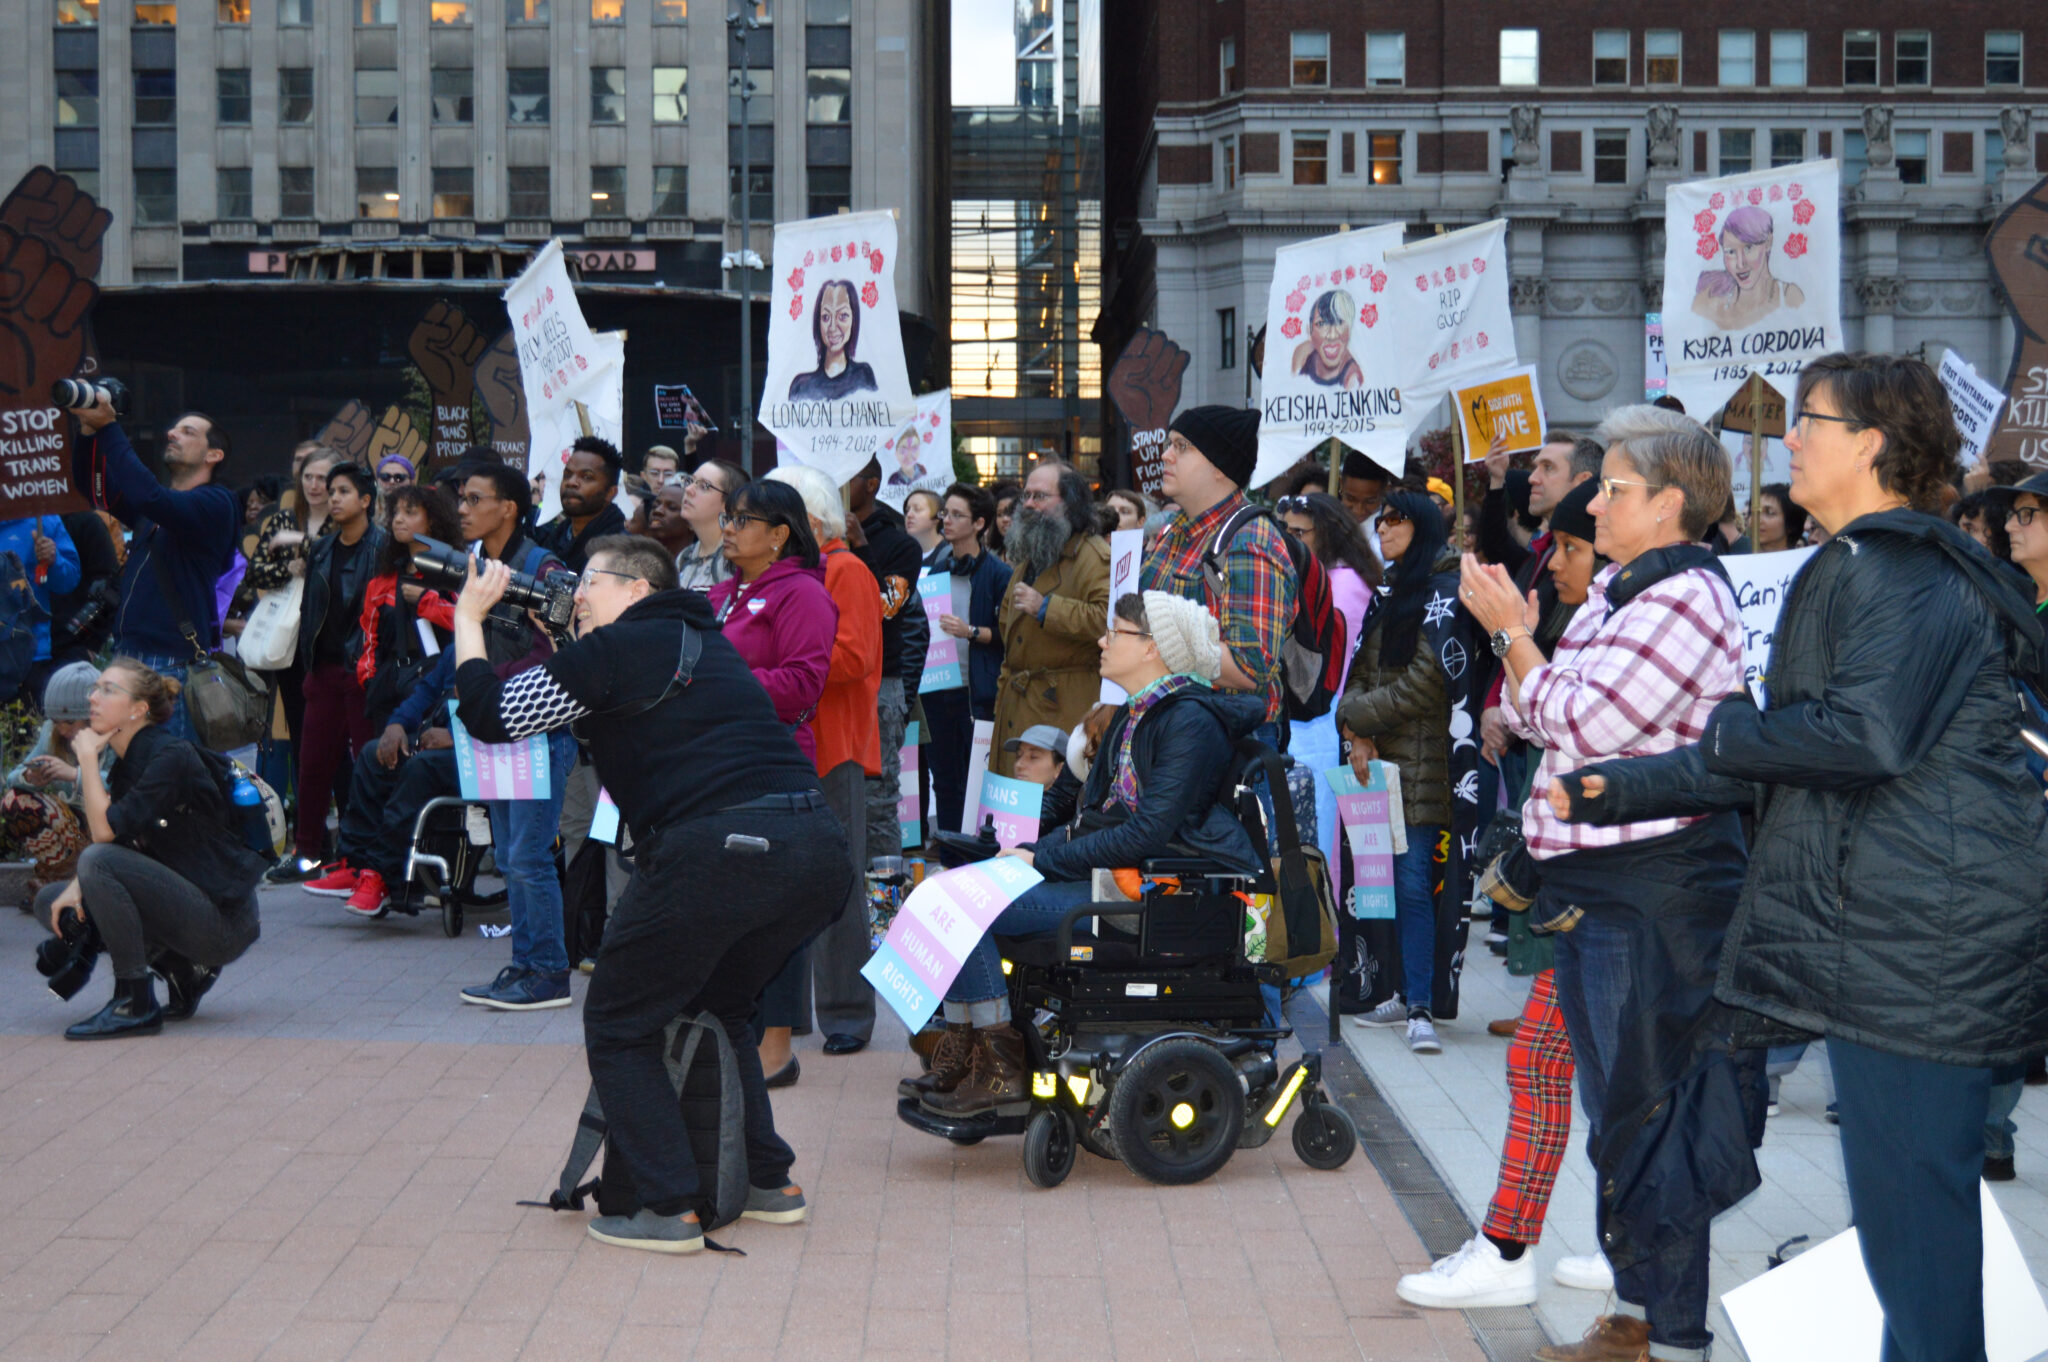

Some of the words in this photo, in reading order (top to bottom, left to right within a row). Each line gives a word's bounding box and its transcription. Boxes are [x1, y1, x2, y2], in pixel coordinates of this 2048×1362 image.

[585, 253, 636, 271] OAD
[1440, 288, 1460, 309] RIP
[1437, 309, 1469, 330] GUCC
[1684, 335, 1733, 360] KYRA
[1741, 326, 1826, 354] CORDOVA
[1265, 393, 1328, 424] KEISHA
[1331, 387, 1402, 418] JENKINS
[1957, 376, 1994, 413] UNITARIAN
[3, 408, 61, 434] STOP
[437, 405, 470, 421] BLACK
[772, 402, 832, 428] LONDON
[841, 402, 896, 427] CHANEL
[1953, 402, 1978, 433] PORTS
[2007, 396, 2048, 429] KILL
[438, 423, 467, 439] TRANS
[1304, 417, 1376, 437] 1993-2015
[1493, 411, 1530, 439] LOVE
[0, 434, 63, 457] KILLING
[812, 435, 877, 452] 1994-2018
[1132, 428, 1166, 450] STAND
[1140, 445, 1160, 462] UP!
[5, 456, 61, 477] TRANS
[1136, 462, 1164, 480] FIGH
[2, 477, 69, 500] WOMEN
[917, 581, 938, 594] ANS
[1737, 574, 1789, 609] Can't
[927, 648, 946, 660] MAN
[921, 669, 951, 685] IGHTS
[477, 740, 491, 780] RIGH
[515, 741, 528, 780] HUM
[532, 736, 545, 779] RIGH
[1344, 773, 1376, 788] TRS
[986, 782, 1019, 806] TRANS
[1351, 801, 1382, 816] RIGHTS
[1364, 832, 1379, 847] ARE
[1360, 864, 1387, 879] HUMAN
[951, 870, 993, 910] RIGHTS
[1362, 895, 1389, 909] RIGHTS
[929, 903, 956, 935] ARE
[900, 927, 945, 980] HUMAN
[881, 960, 924, 1011] RIGHTS
